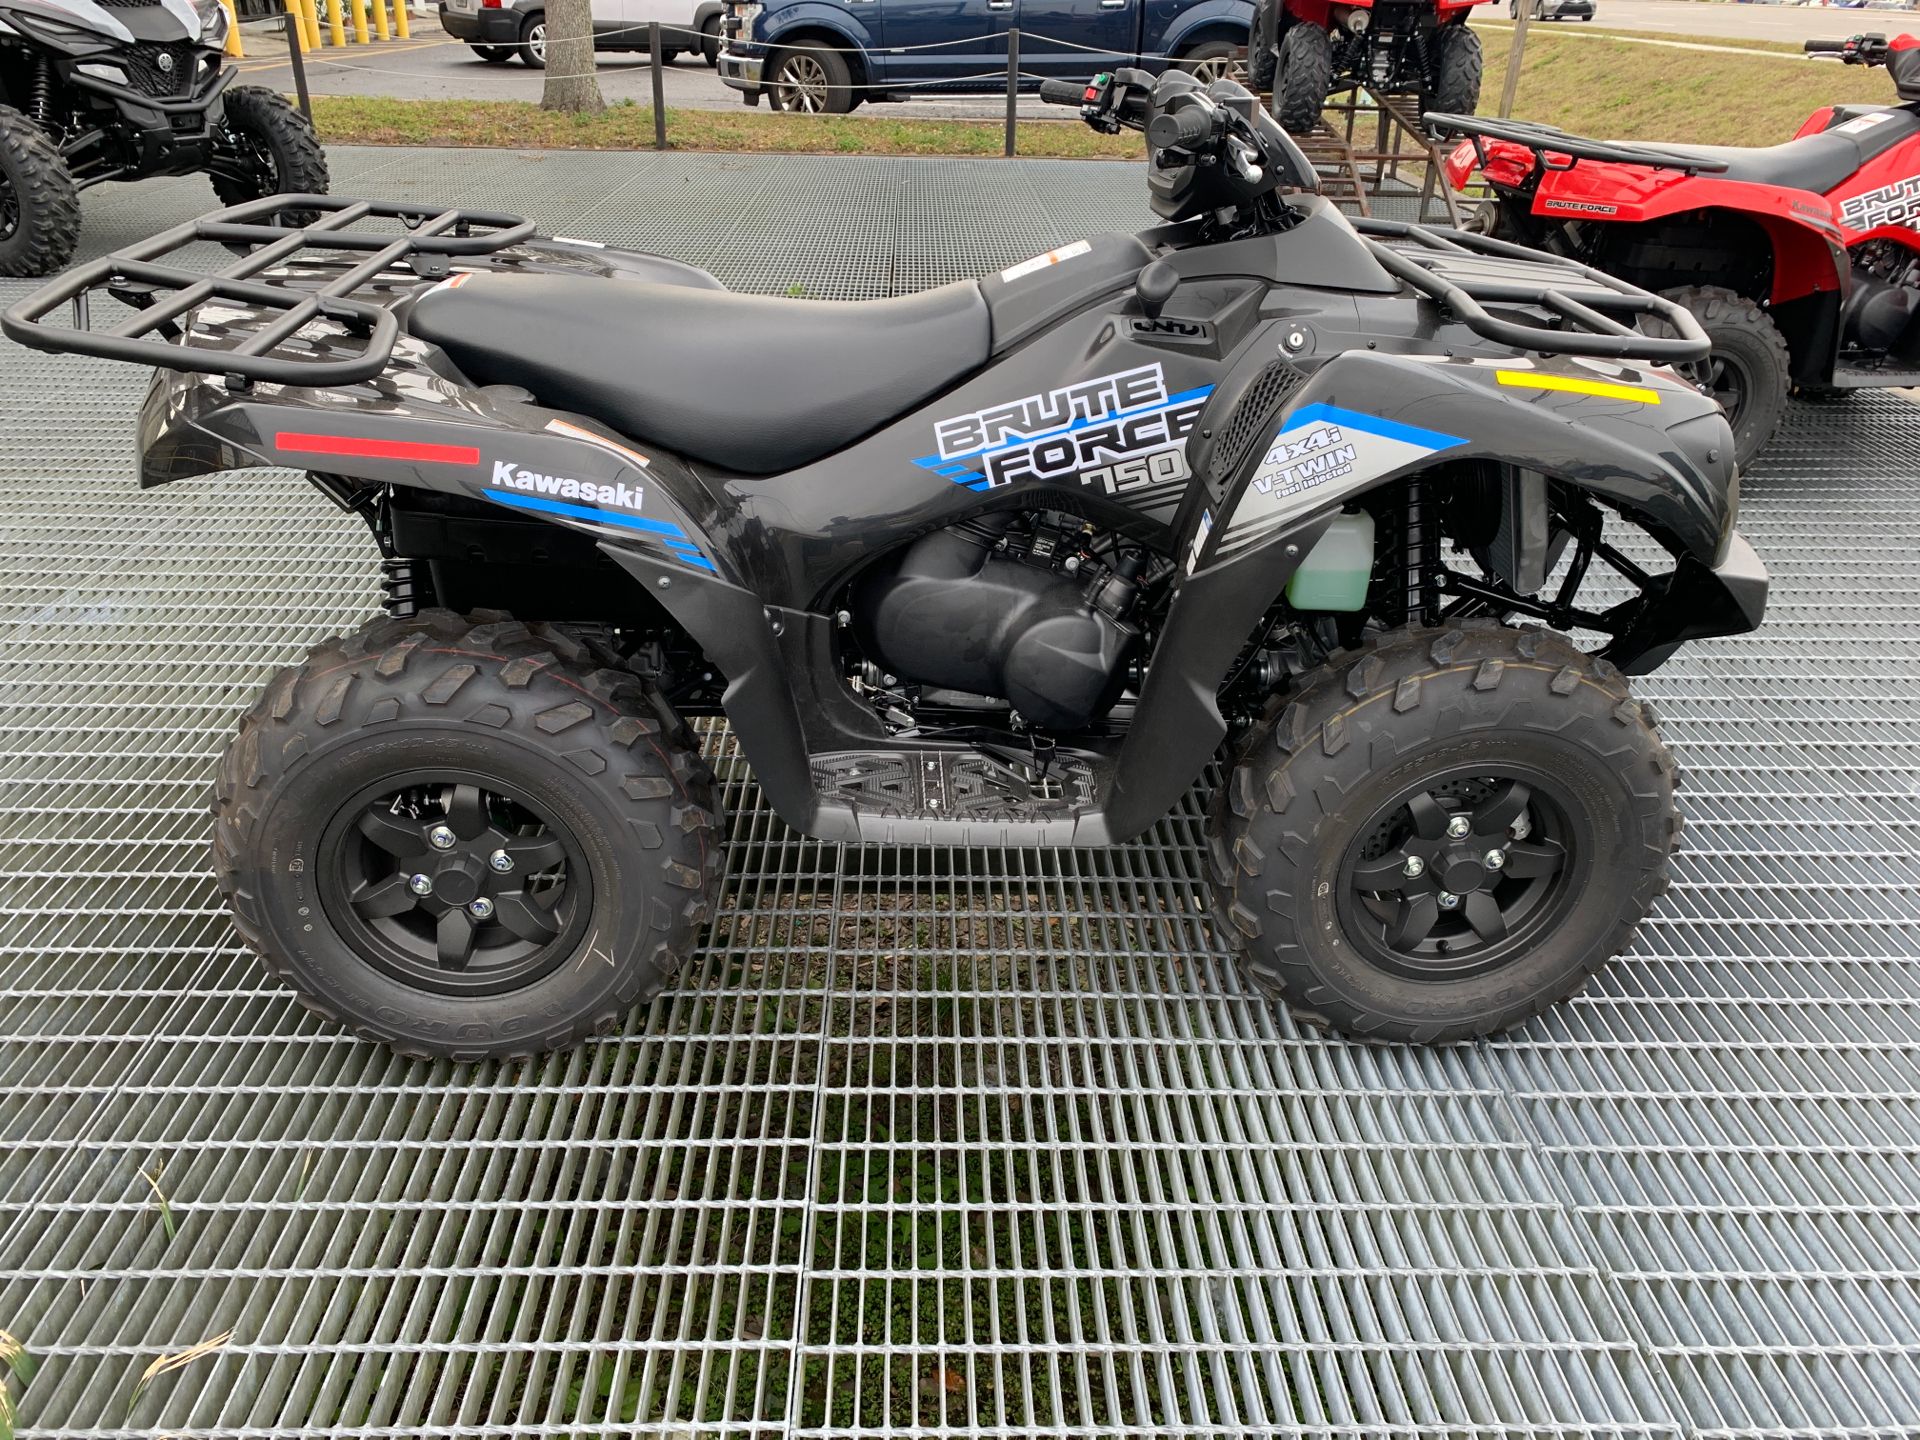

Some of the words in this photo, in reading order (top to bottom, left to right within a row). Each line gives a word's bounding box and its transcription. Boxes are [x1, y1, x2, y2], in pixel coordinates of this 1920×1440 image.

[1545, 199, 1580, 211] BRUTE
[1580, 202, 1618, 215] FORCE
[934, 362, 1168, 461] BRUTE
[983, 397, 1205, 488] FORCE
[1265, 426, 1342, 465] 4x4i
[492, 460, 643, 510] Kawasaki
[1080, 448, 1188, 494] 750
[1252, 443, 1357, 495] V-TWIN
[1275, 483, 1301, 499] Fuel
